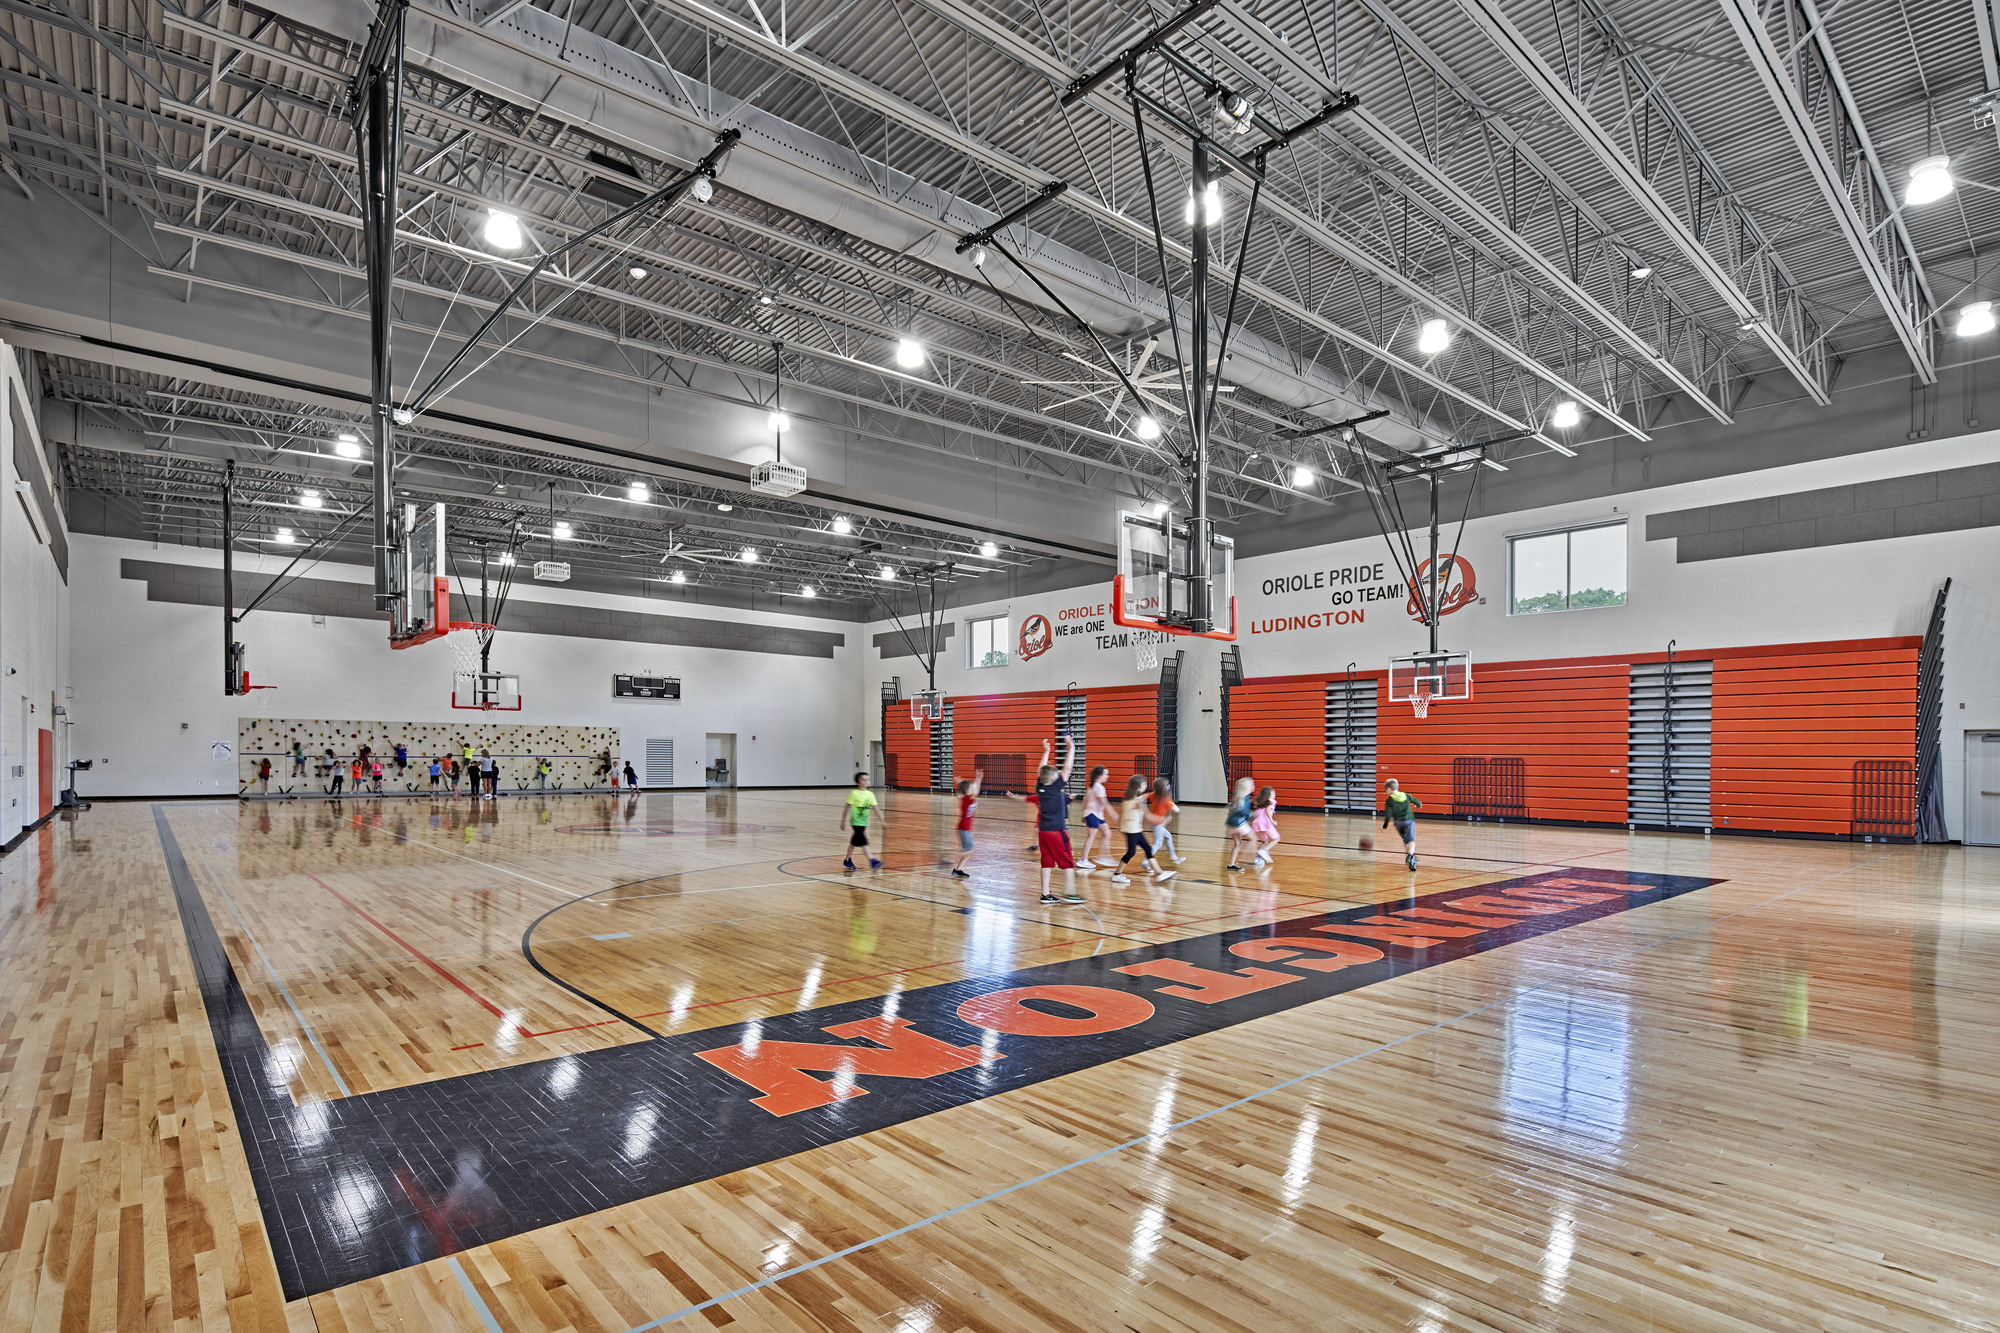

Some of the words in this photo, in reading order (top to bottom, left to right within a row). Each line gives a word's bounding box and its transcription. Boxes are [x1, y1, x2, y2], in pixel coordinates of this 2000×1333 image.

[1262, 572, 1324, 595] ORIOLE
[1329, 563, 1384, 586] PRIDE
[1331, 590, 1353, 605] GO
[1357, 583, 1404, 603] TEAM!
[1058, 604, 1105, 621] ORIOLE
[1109, 596, 1159, 614] NTION
[1251, 608, 1365, 634] LUDINGTON
[1055, 625, 1068, 637] WE
[1070, 625, 1084, 635] are
[1085, 620, 1105, 633] ONE
[1096, 633, 1128, 649] TEAM
[693, 878, 1656, 1118] LUDINGTON
